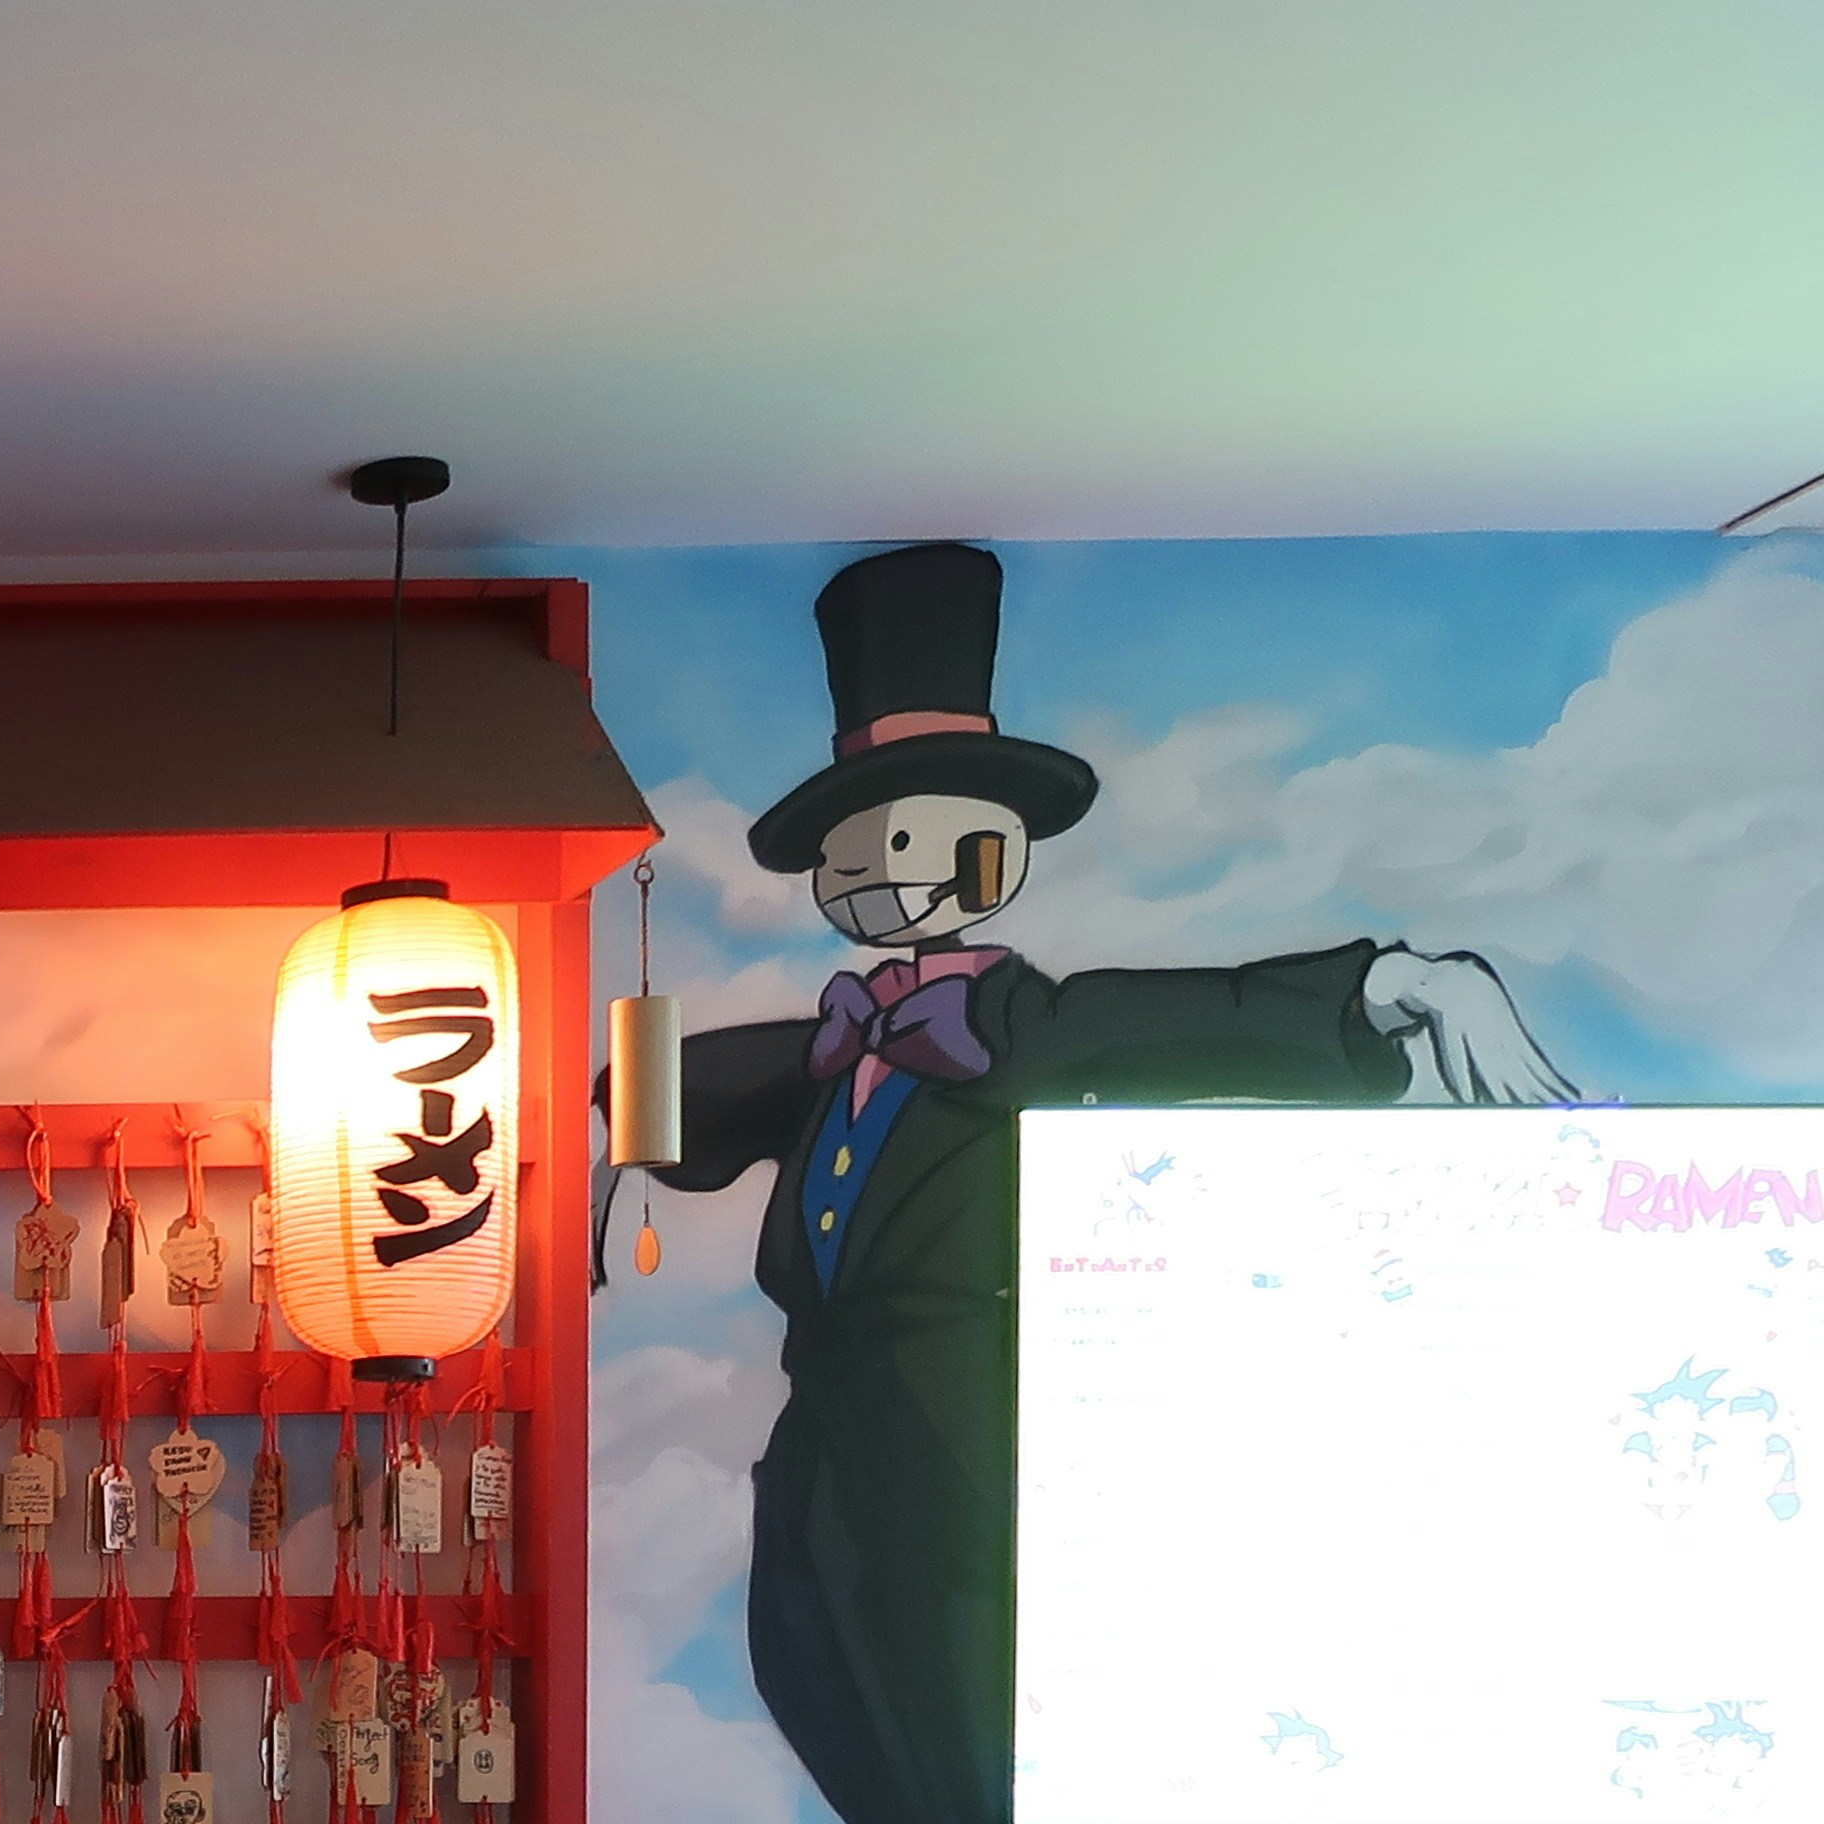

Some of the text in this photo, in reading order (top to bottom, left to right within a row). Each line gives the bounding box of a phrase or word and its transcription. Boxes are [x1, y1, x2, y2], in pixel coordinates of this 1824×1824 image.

[368, 986, 494, 1267] ラーメン
[1600, 1158, 1824, 1234] RAMEN
